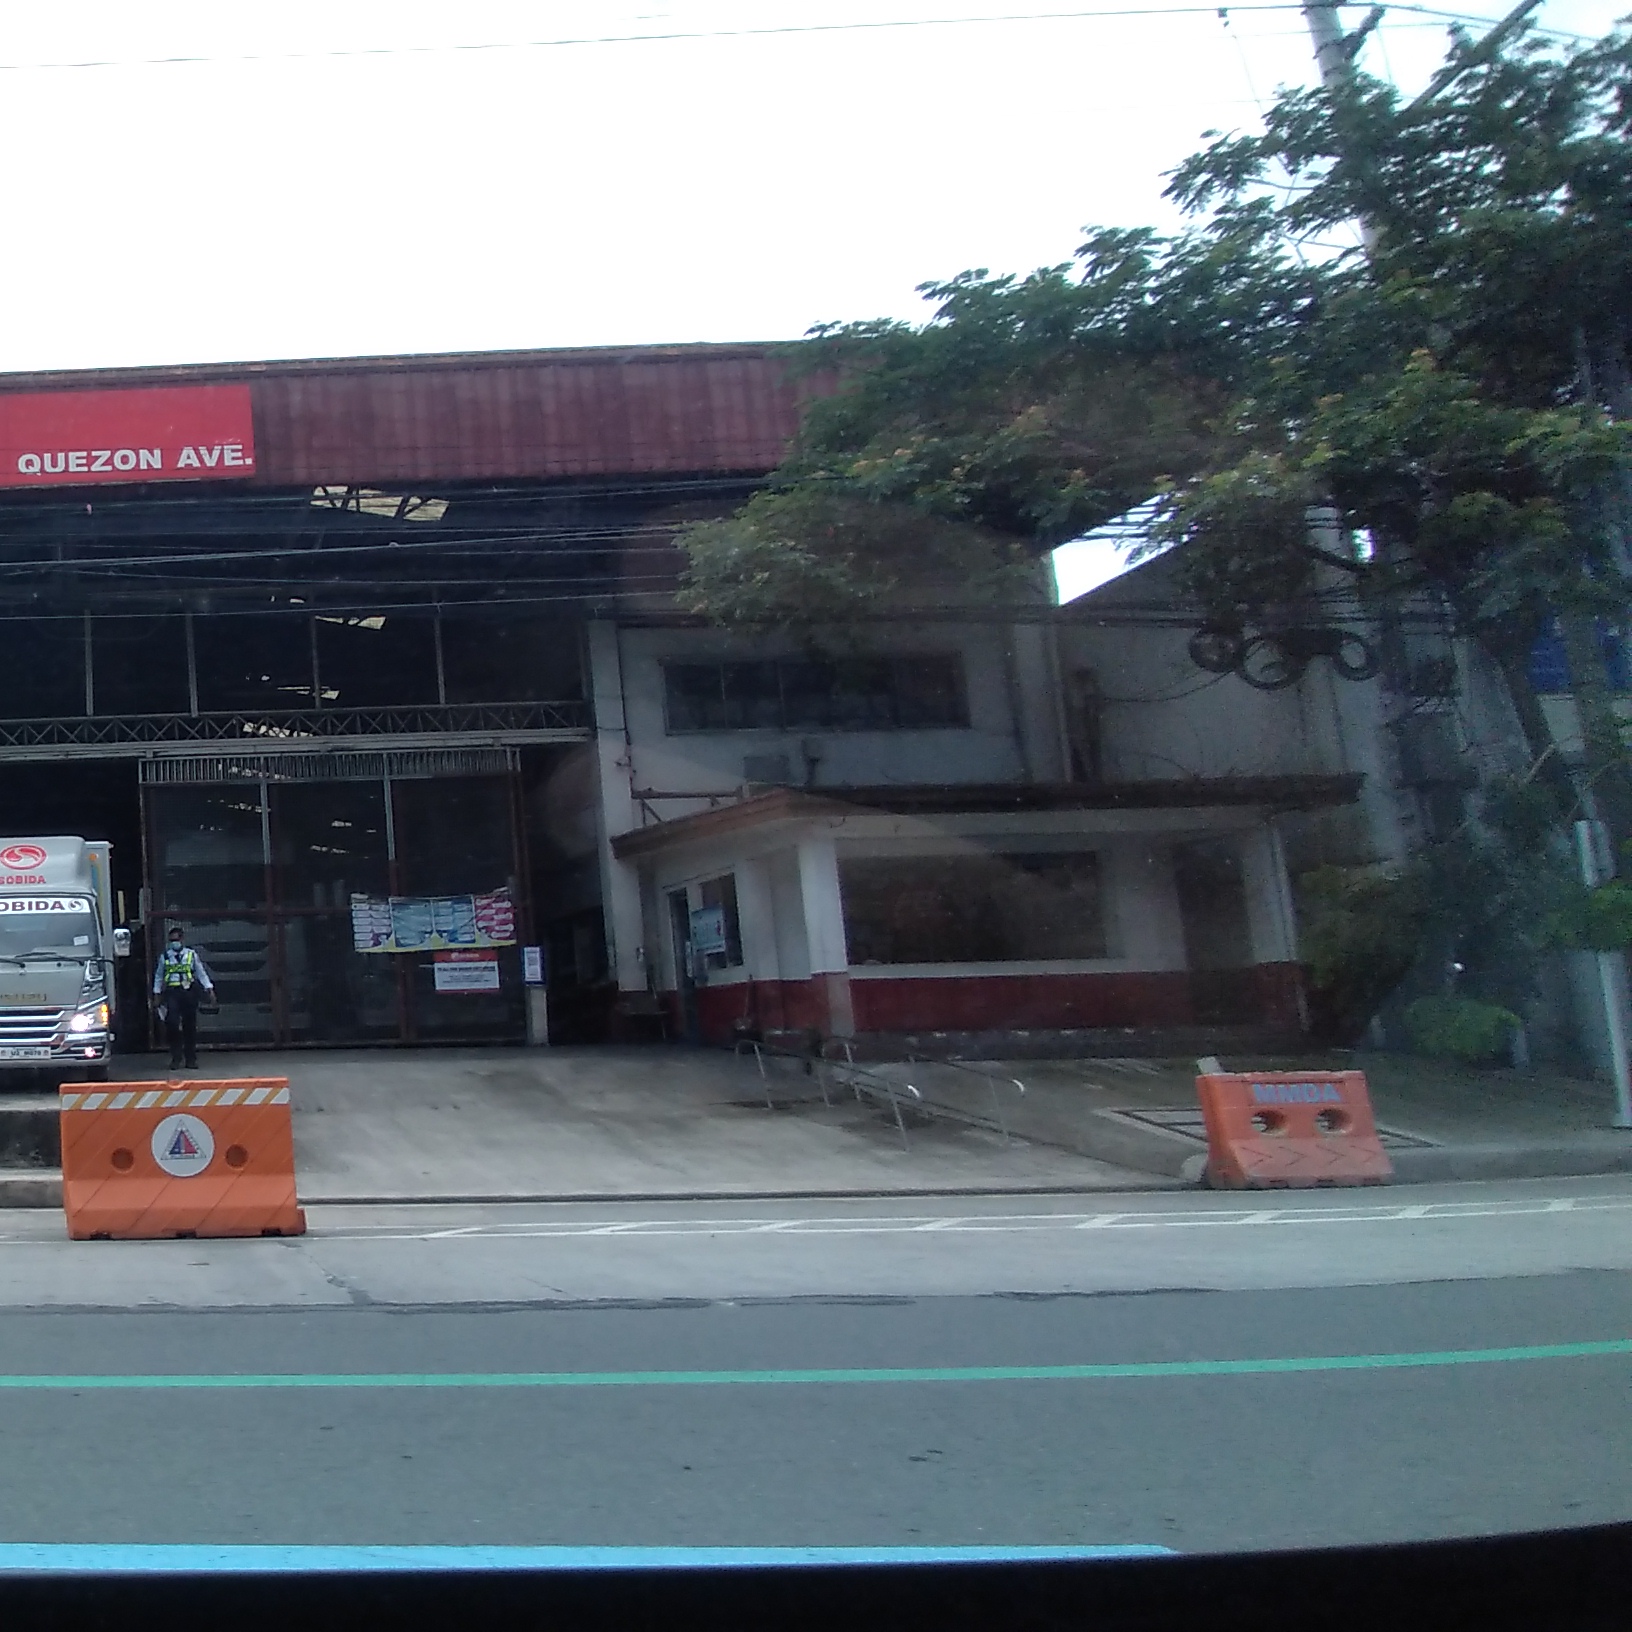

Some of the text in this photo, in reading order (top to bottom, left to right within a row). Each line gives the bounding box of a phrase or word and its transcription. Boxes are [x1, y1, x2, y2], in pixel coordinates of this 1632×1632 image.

[18, 448, 162, 475] QUEZON
[176, 445, 253, 468] AVE.
[1252, 1083, 1341, 1103] MMDA
